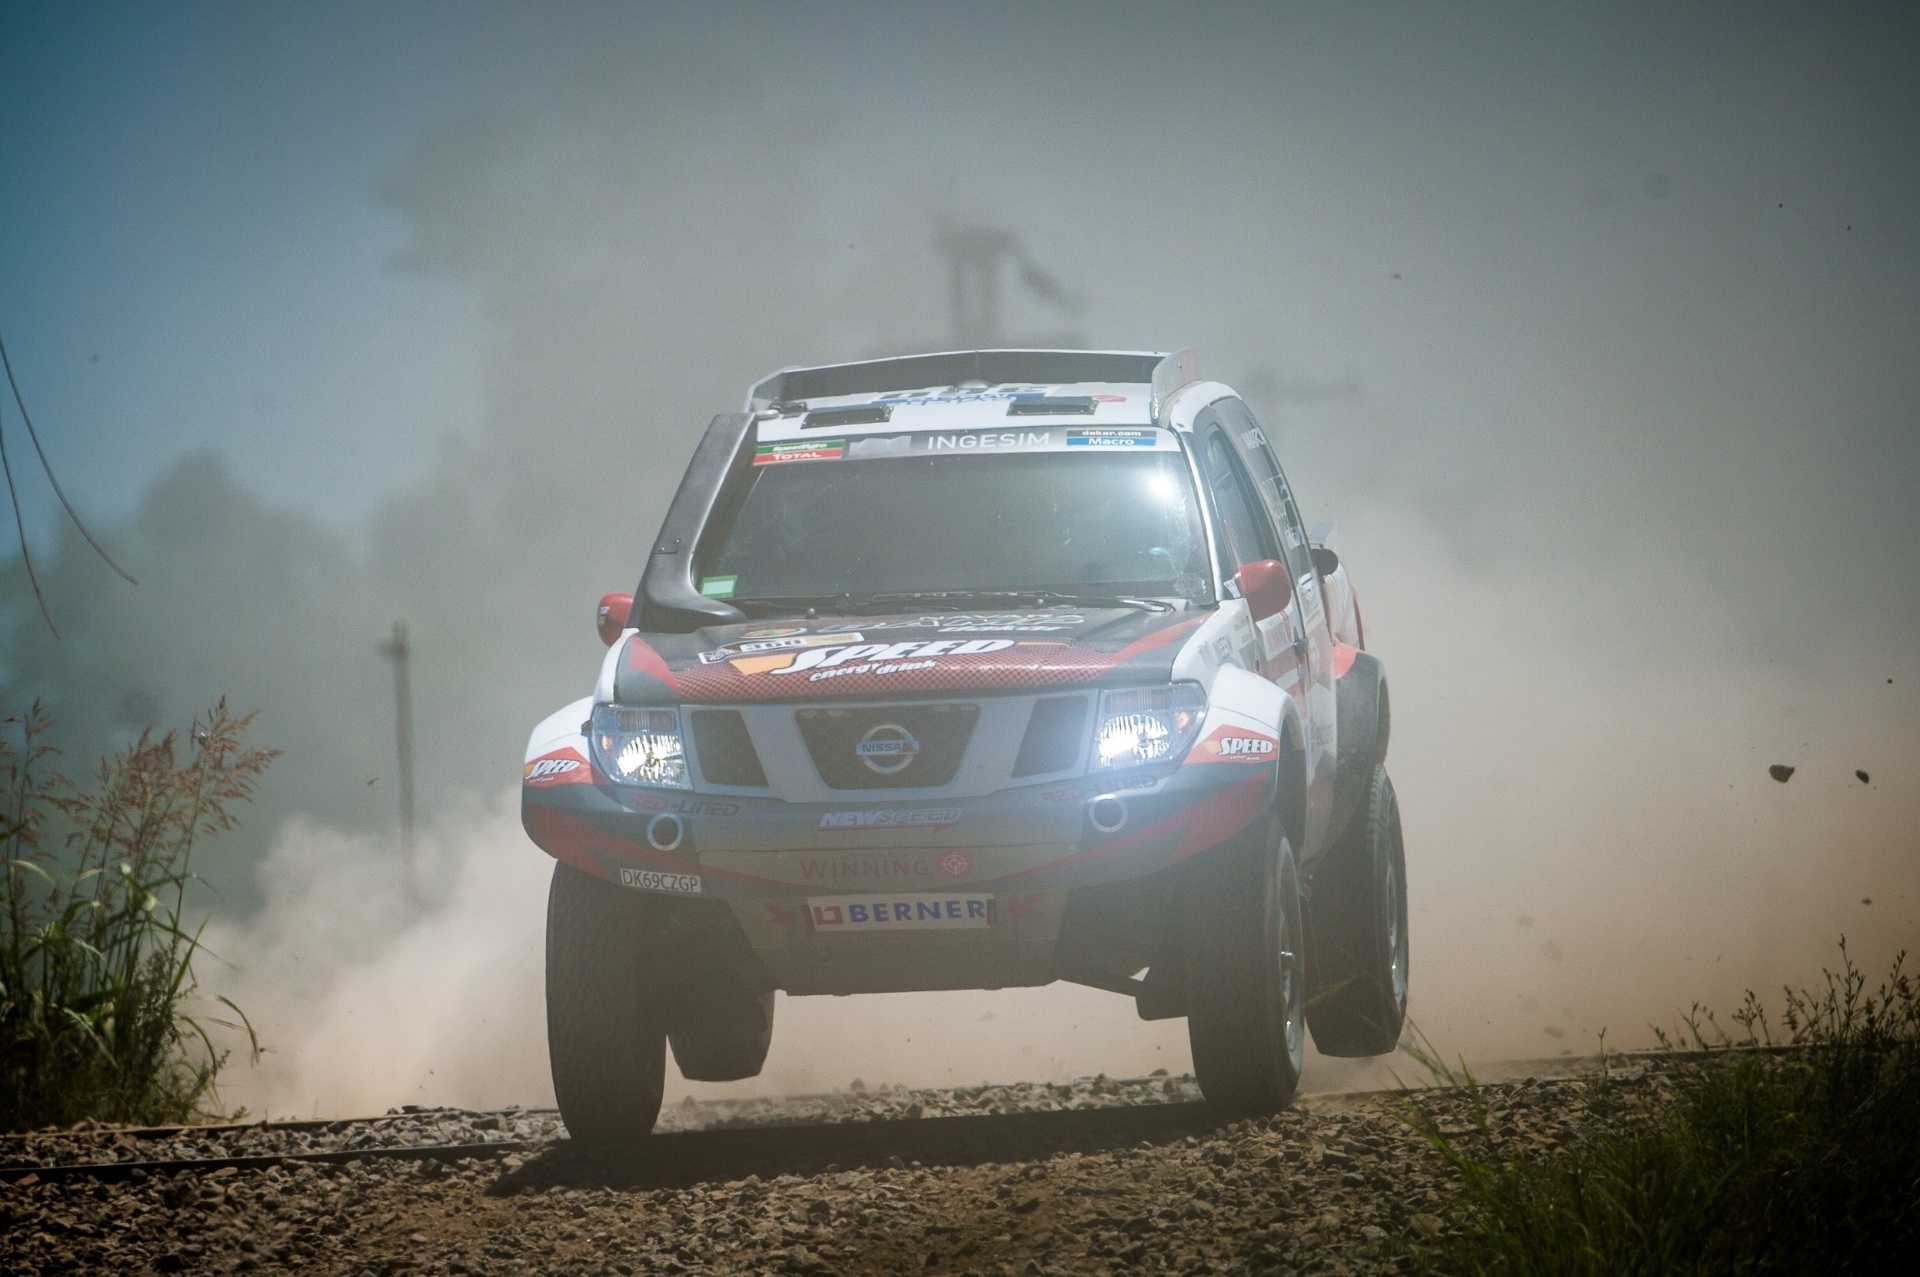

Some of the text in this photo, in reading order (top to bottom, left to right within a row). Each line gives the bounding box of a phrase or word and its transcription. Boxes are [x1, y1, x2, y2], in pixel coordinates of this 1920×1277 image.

[927, 432, 1050, 450] INGESIM
[1088, 437, 1135, 446] Macro
[773, 451, 822, 461] TOTAL
[771, 639, 1015, 675] SPEED
[809, 660, 938, 682] energy drink
[862, 741, 913, 753] NISSAN
[1218, 737, 1274, 756] SPEED
[524, 759, 581, 780] SPEED
[621, 869, 699, 893] DK69CZGP
[848, 899, 987, 923] BERNER
